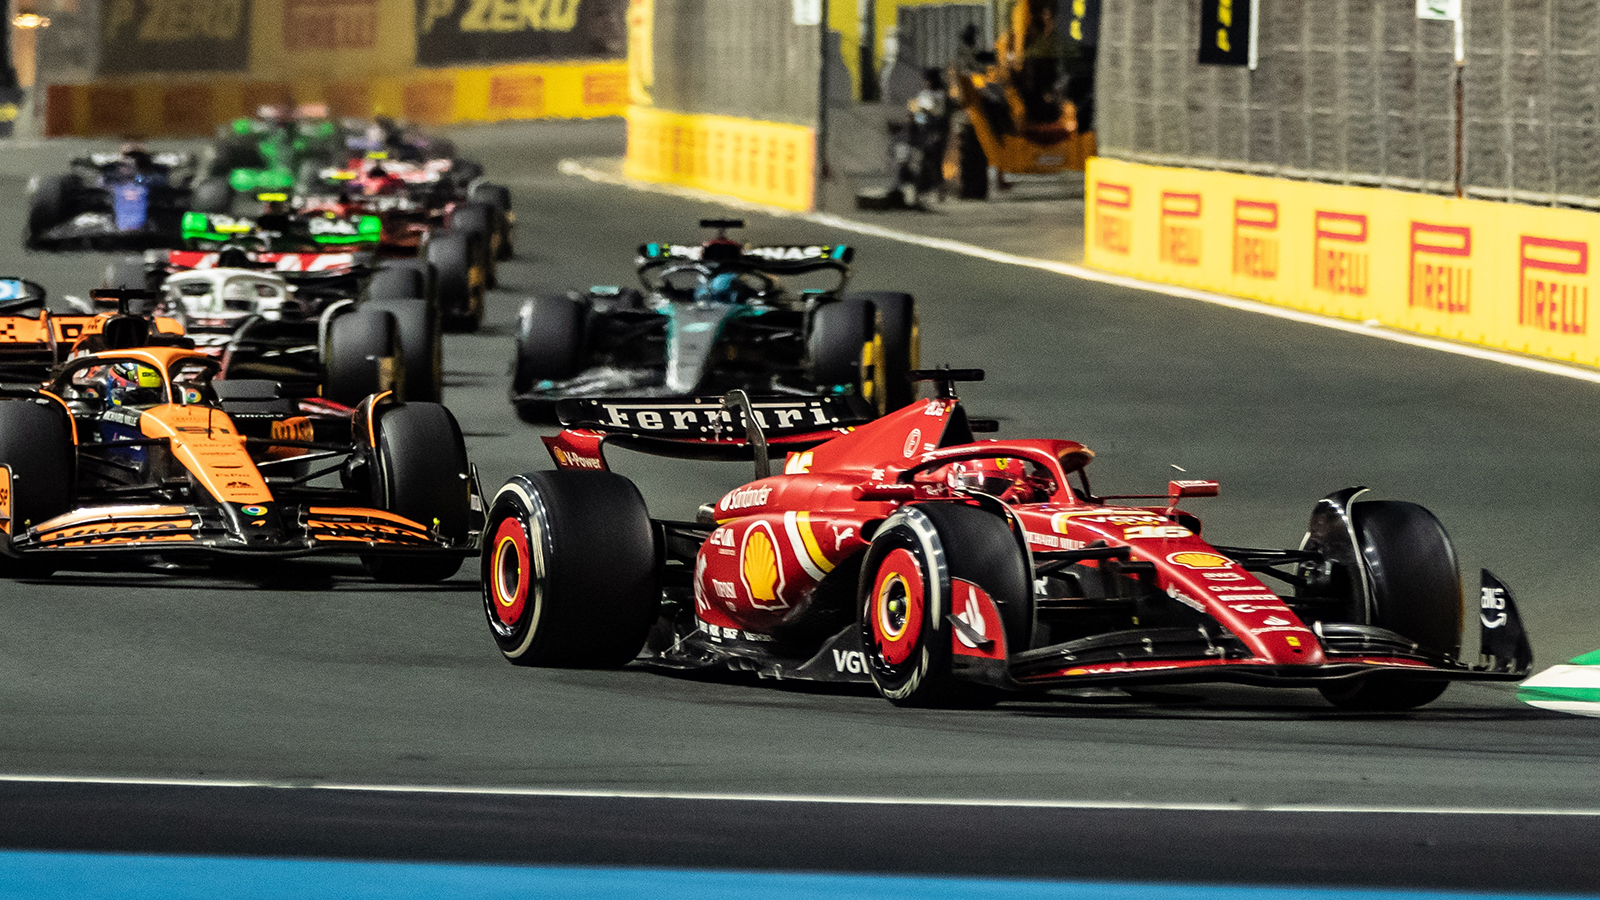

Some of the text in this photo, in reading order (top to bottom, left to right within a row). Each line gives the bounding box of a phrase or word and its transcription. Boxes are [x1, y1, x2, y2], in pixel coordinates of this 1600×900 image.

[1408, 220, 1472, 315] PIRELLI
[1518, 234, 1589, 336] PIRELLI
[562, 451, 602, 469] V-Power
[729, 484, 773, 510] Santander
[1123, 525, 1194, 541] 16
